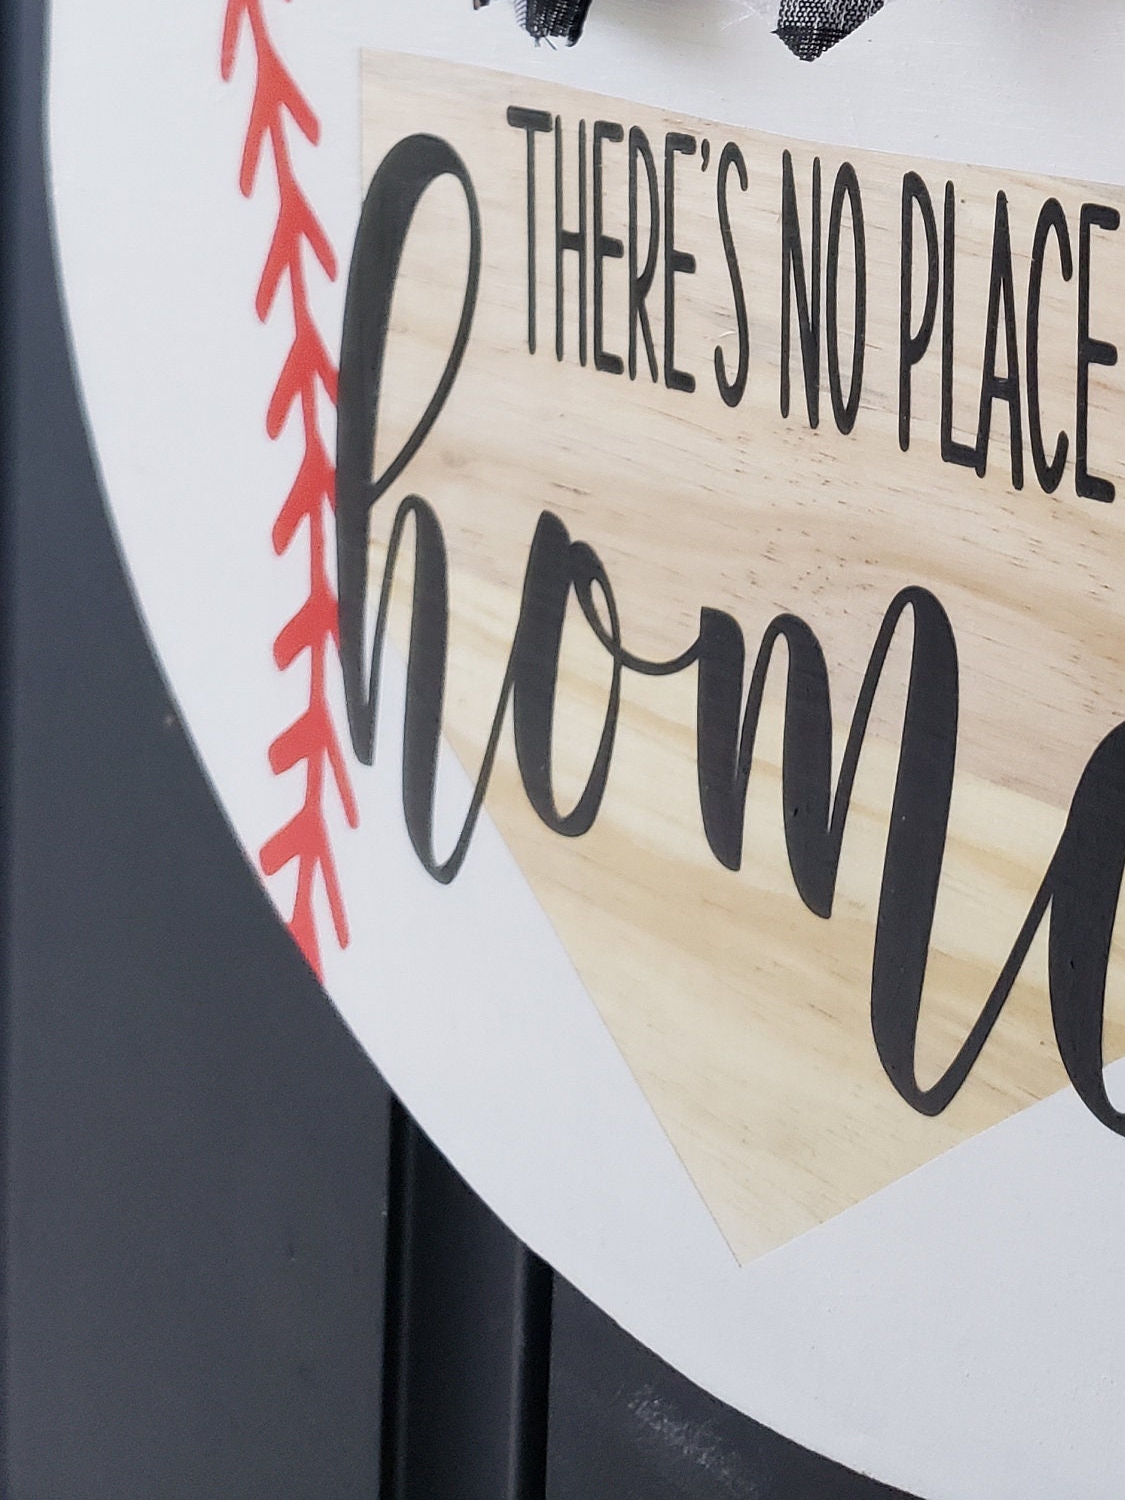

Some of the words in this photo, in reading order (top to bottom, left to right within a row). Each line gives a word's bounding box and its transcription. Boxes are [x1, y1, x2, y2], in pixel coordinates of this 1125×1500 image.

[506, 105, 750, 408] THERE'S
[780, 149, 867, 436] NO
[897, 170, 1121, 504] PLACE
